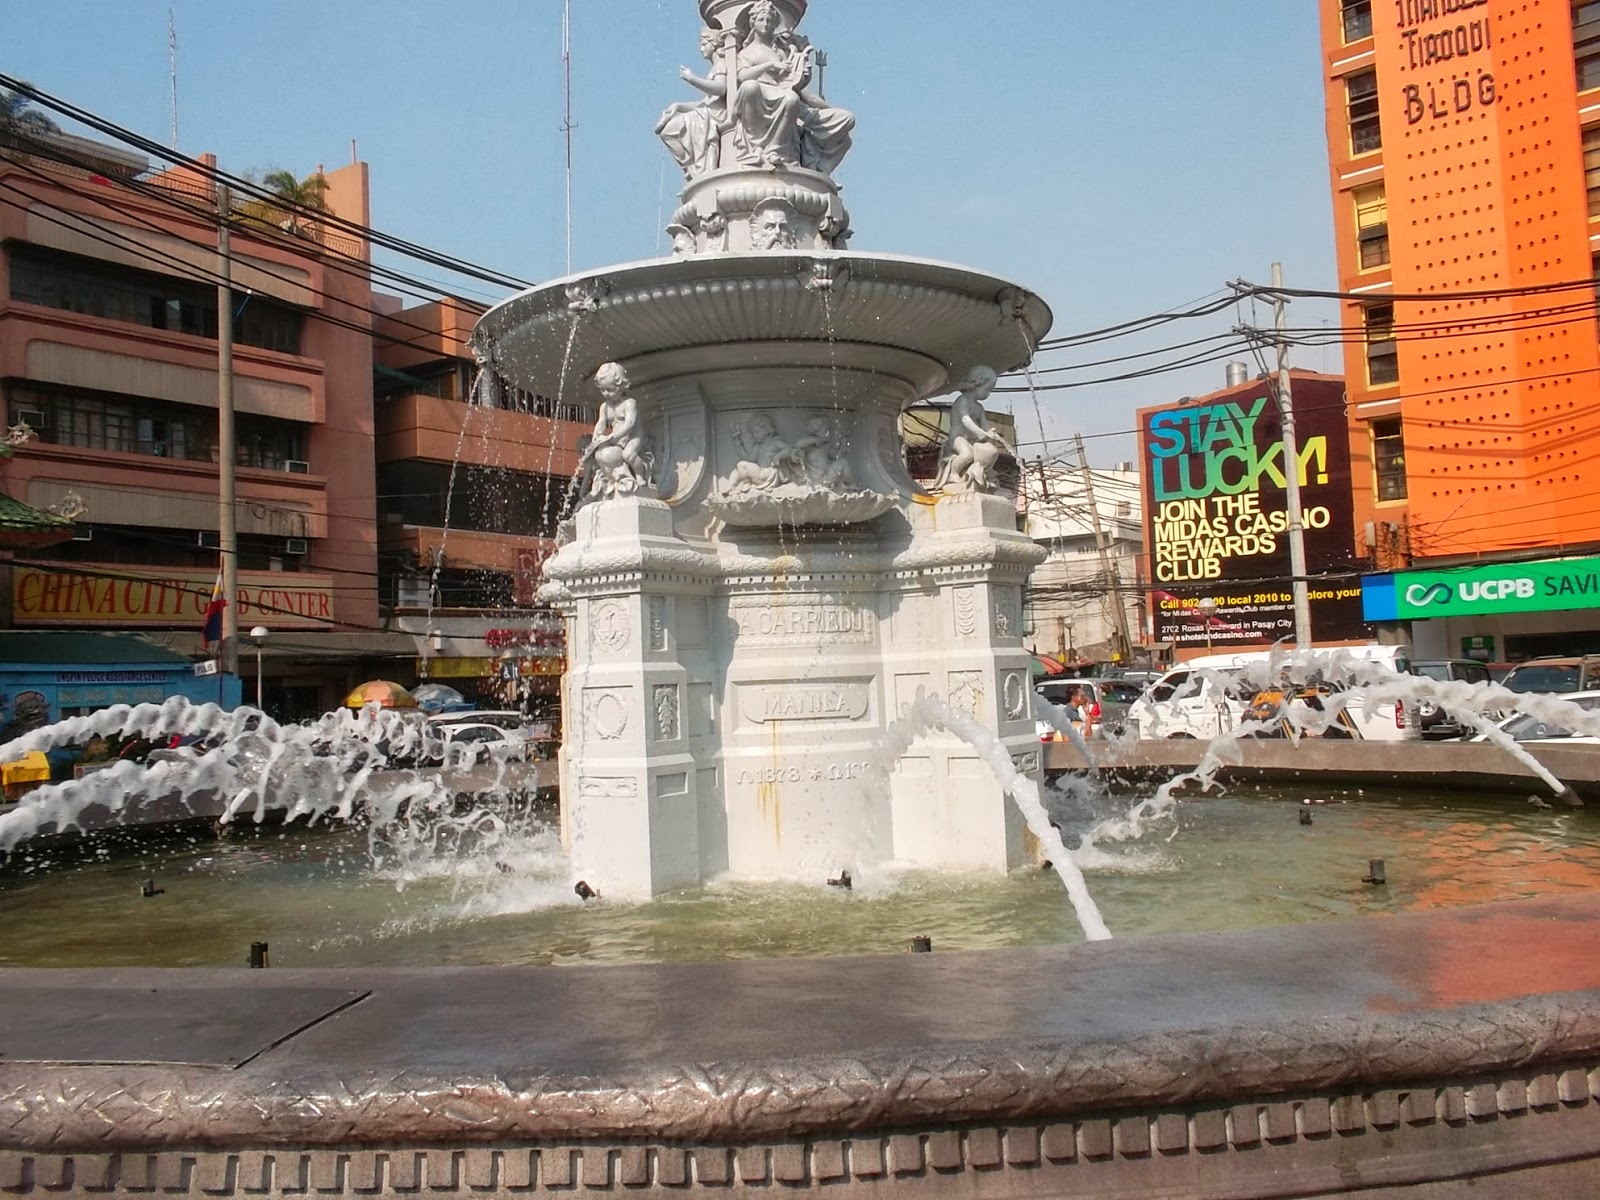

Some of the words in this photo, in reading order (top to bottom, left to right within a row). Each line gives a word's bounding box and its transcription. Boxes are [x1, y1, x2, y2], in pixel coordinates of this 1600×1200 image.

[1405, 73, 1496, 125] BLDG
[1149, 398, 1268, 457] STAY
[1152, 436, 1329, 502] LUCKY!
[1153, 500, 1206, 523] JOIN
[1212, 493, 1260, 516] THE
[1154, 514, 1229, 543] MIDAS
[1156, 533, 1276, 562] REWARDS
[1156, 558, 1222, 582] CLUB
[17, 572, 117, 614] CHINA
[124, 577, 189, 615] CITY
[194, 587, 250, 615] GD
[259, 590, 331, 617] CENTER
[1160, 600, 1179, 609] Call
[1227, 595, 1251, 605] local
[1253, 593, 1278, 603] 2010
[1280, 592, 1291, 602] to
[1336, 588, 1361, 601] your
[1459, 578, 1535, 602] UCPB
[1544, 573, 1598, 597] SAVI
[1182, 624, 1204, 633] Roxas
[1243, 621, 1251, 629] in
[1251, 620, 1275, 629] Pasay
[1277, 619, 1293, 628] City
[764, 690, 851, 715] MANILA
